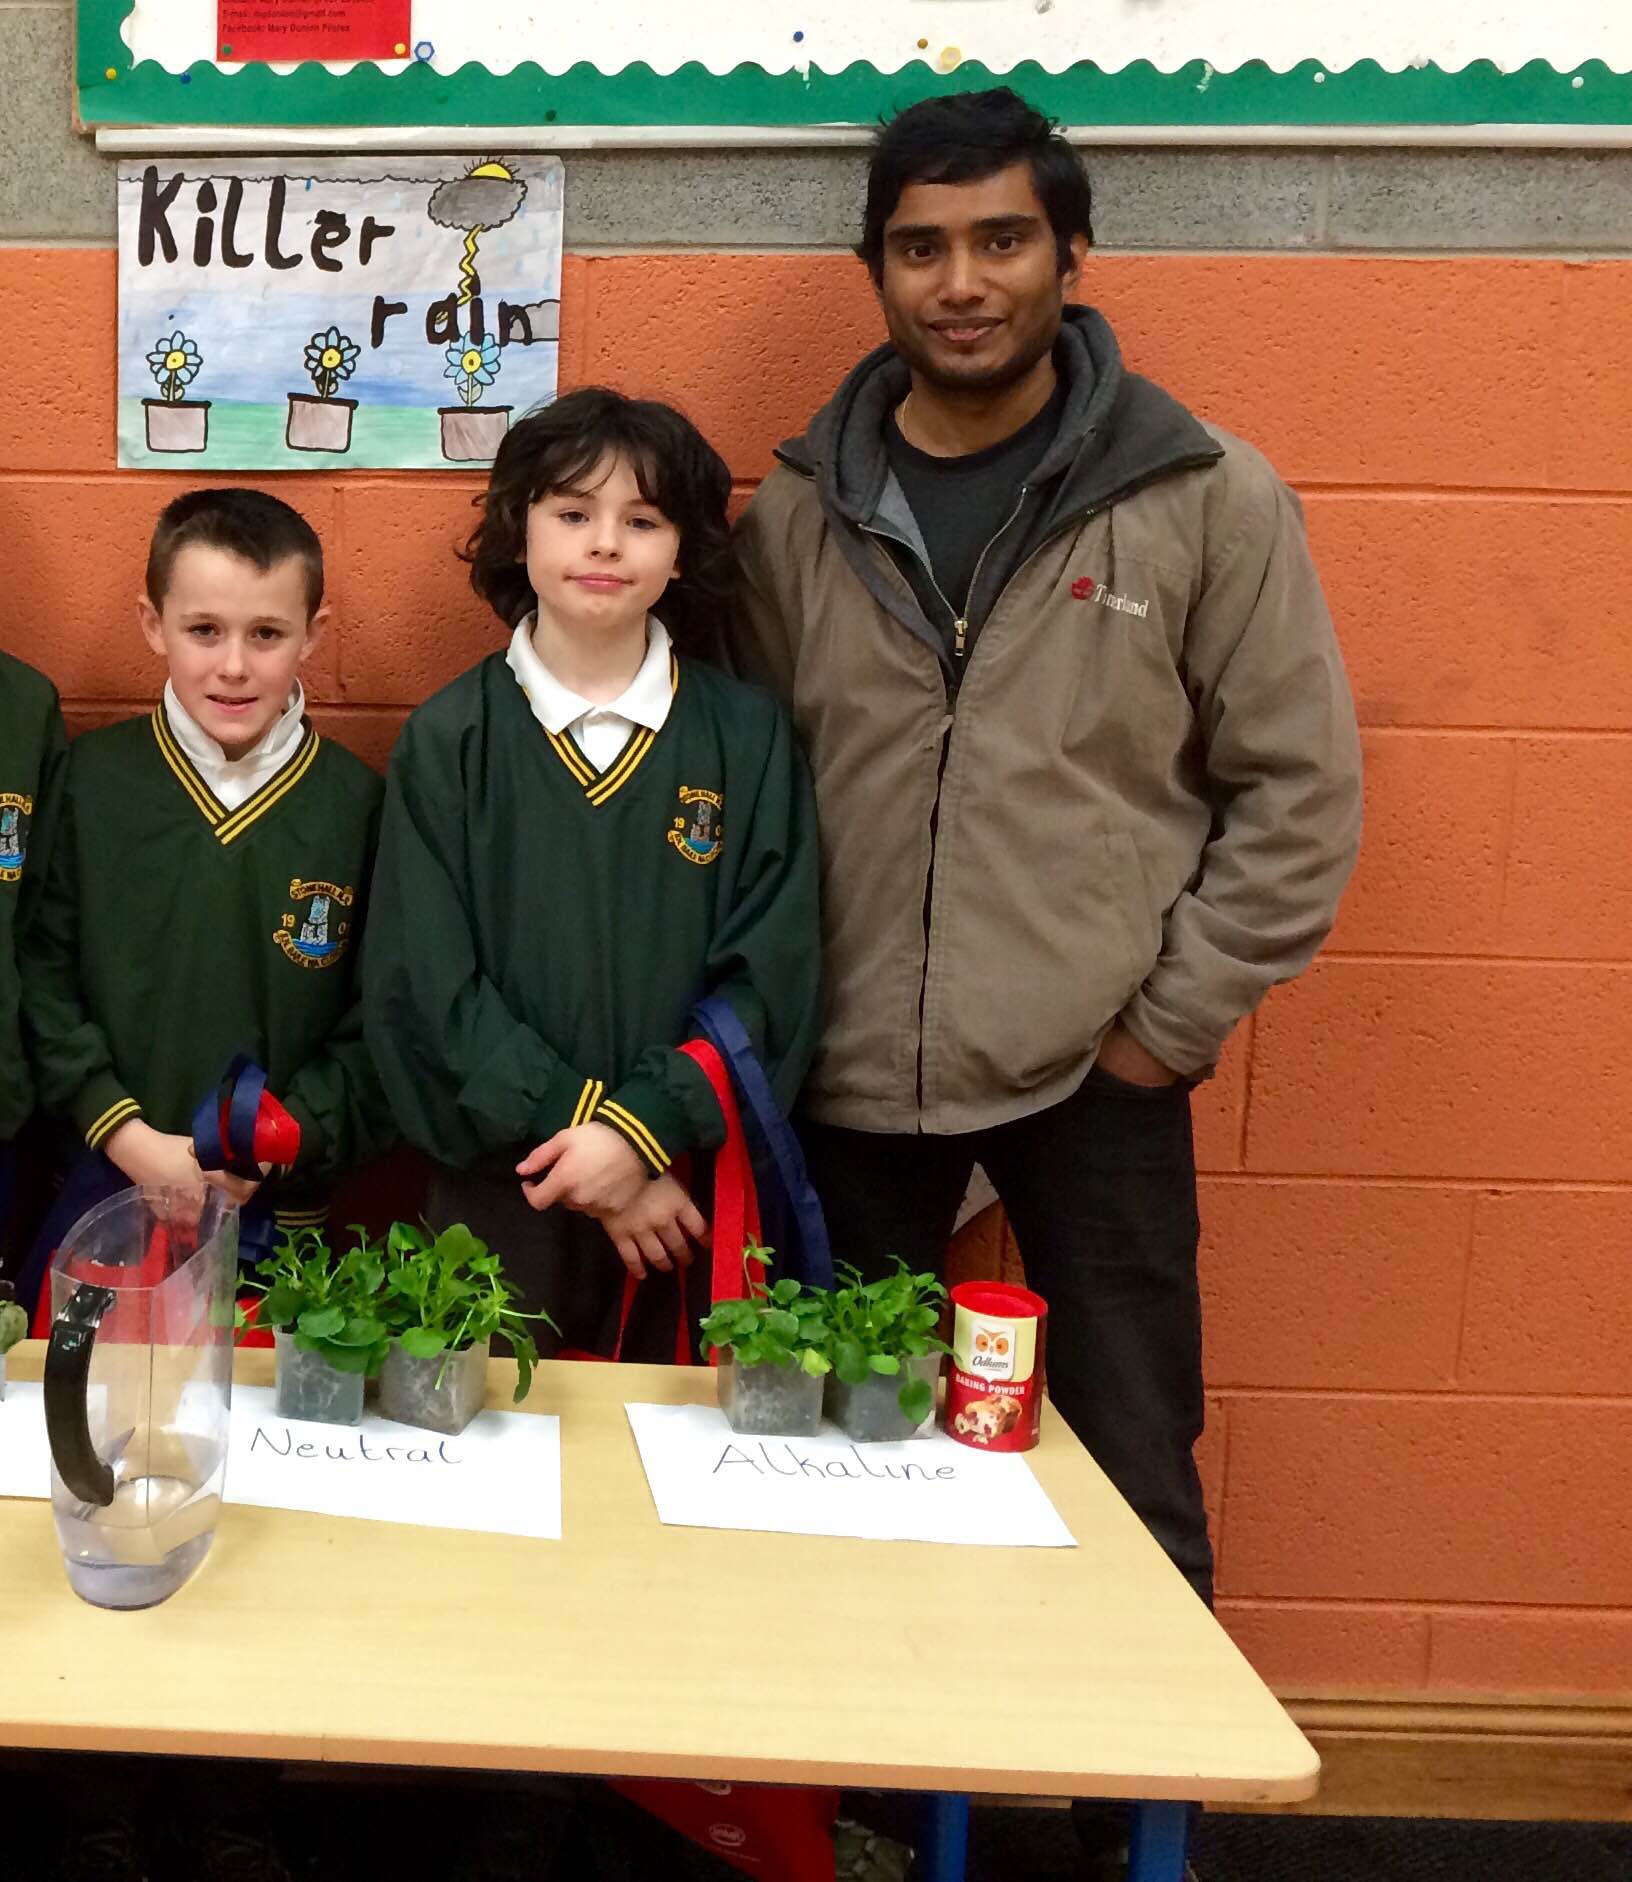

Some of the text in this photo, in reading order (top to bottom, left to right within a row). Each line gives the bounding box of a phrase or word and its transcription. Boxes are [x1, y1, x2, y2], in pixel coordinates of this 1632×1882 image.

[267, 24, 288, 34] Mary
[137, 166, 395, 273] Killer
[370, 273, 534, 348] rain
[281, 913, 296, 928] 19
[955, 1373, 1025, 1395] BAKING POWDER
[250, 1427, 464, 1466] Neutral
[712, 1442, 958, 1481] Alkaline
